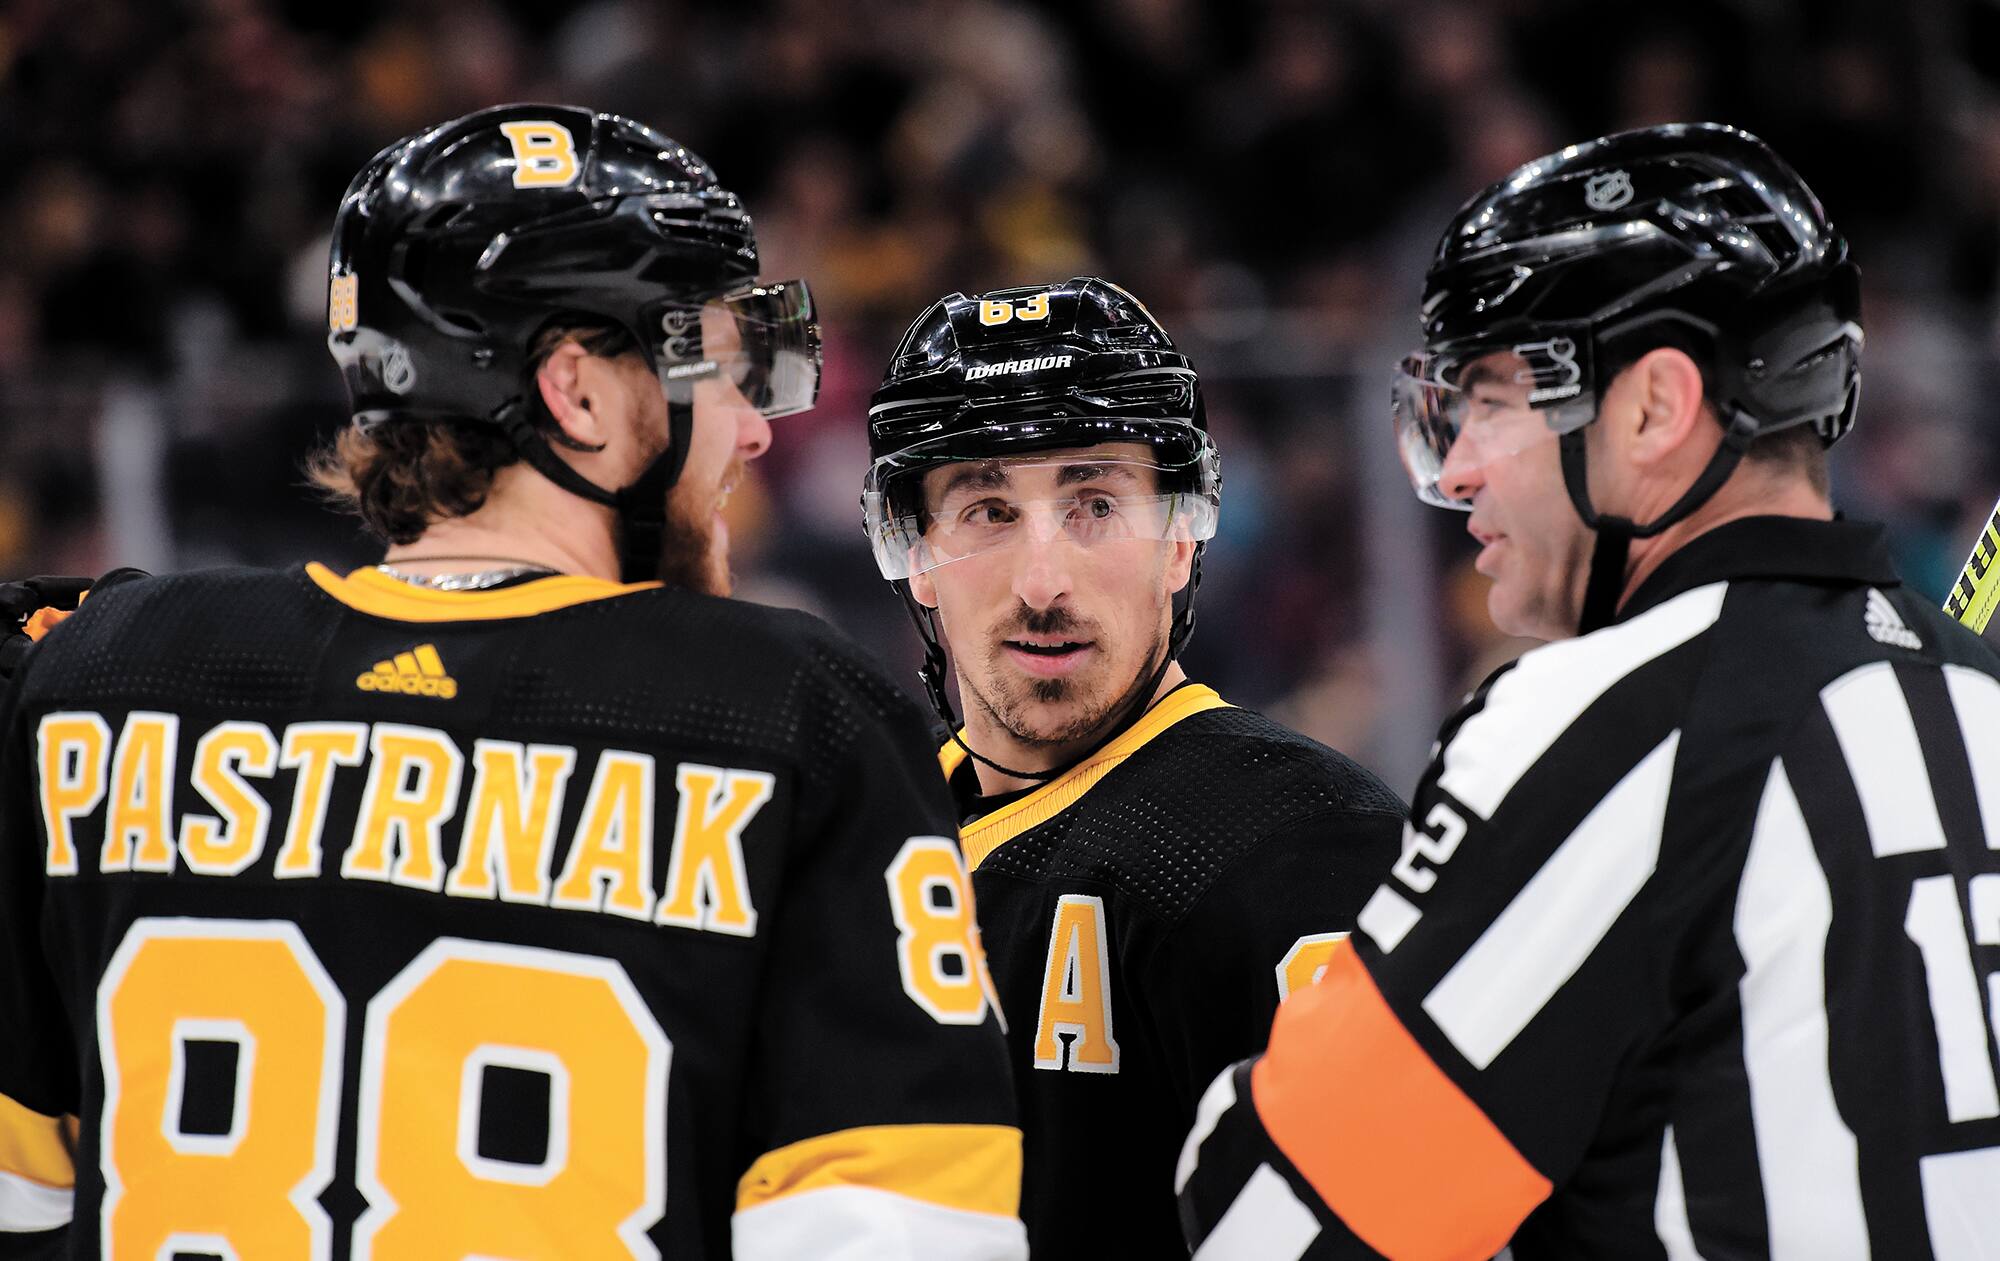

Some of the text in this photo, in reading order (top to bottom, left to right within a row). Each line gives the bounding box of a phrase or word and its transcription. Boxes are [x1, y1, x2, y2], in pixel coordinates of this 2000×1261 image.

[500, 120, 581, 188] B
[329, 272, 358, 333] 88
[979, 293, 1050, 326] 63
[965, 355, 1072, 381] WARRIOR
[356, 671, 458, 700] adidas
[36, 710, 776, 938] PASTRNAK
[1034, 893, 1120, 1074] A
[97, 917, 673, 1261] 88
